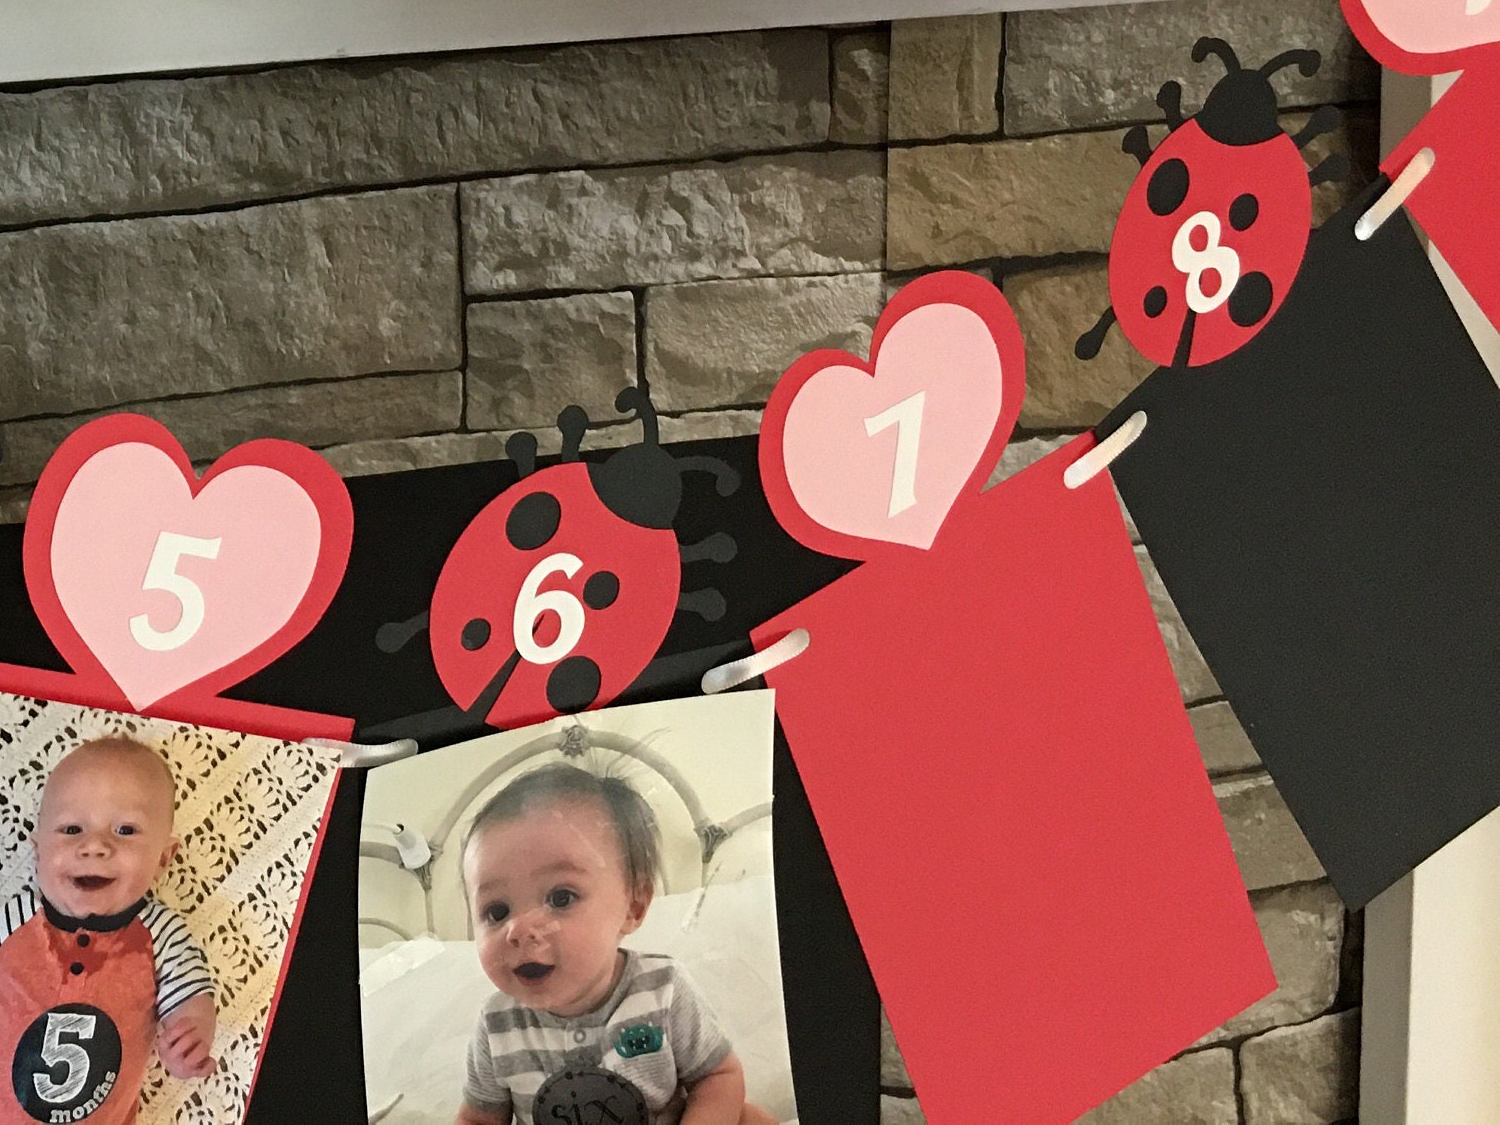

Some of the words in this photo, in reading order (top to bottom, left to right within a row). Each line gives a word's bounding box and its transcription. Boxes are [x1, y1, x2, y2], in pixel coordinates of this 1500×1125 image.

[1172, 211, 1240, 314] 8
[863, 389, 926, 518] 7
[128, 531, 223, 652] 5
[513, 552, 586, 664] 6
[33, 1012, 97, 1103] 5
[49, 1070, 117, 1124] months
